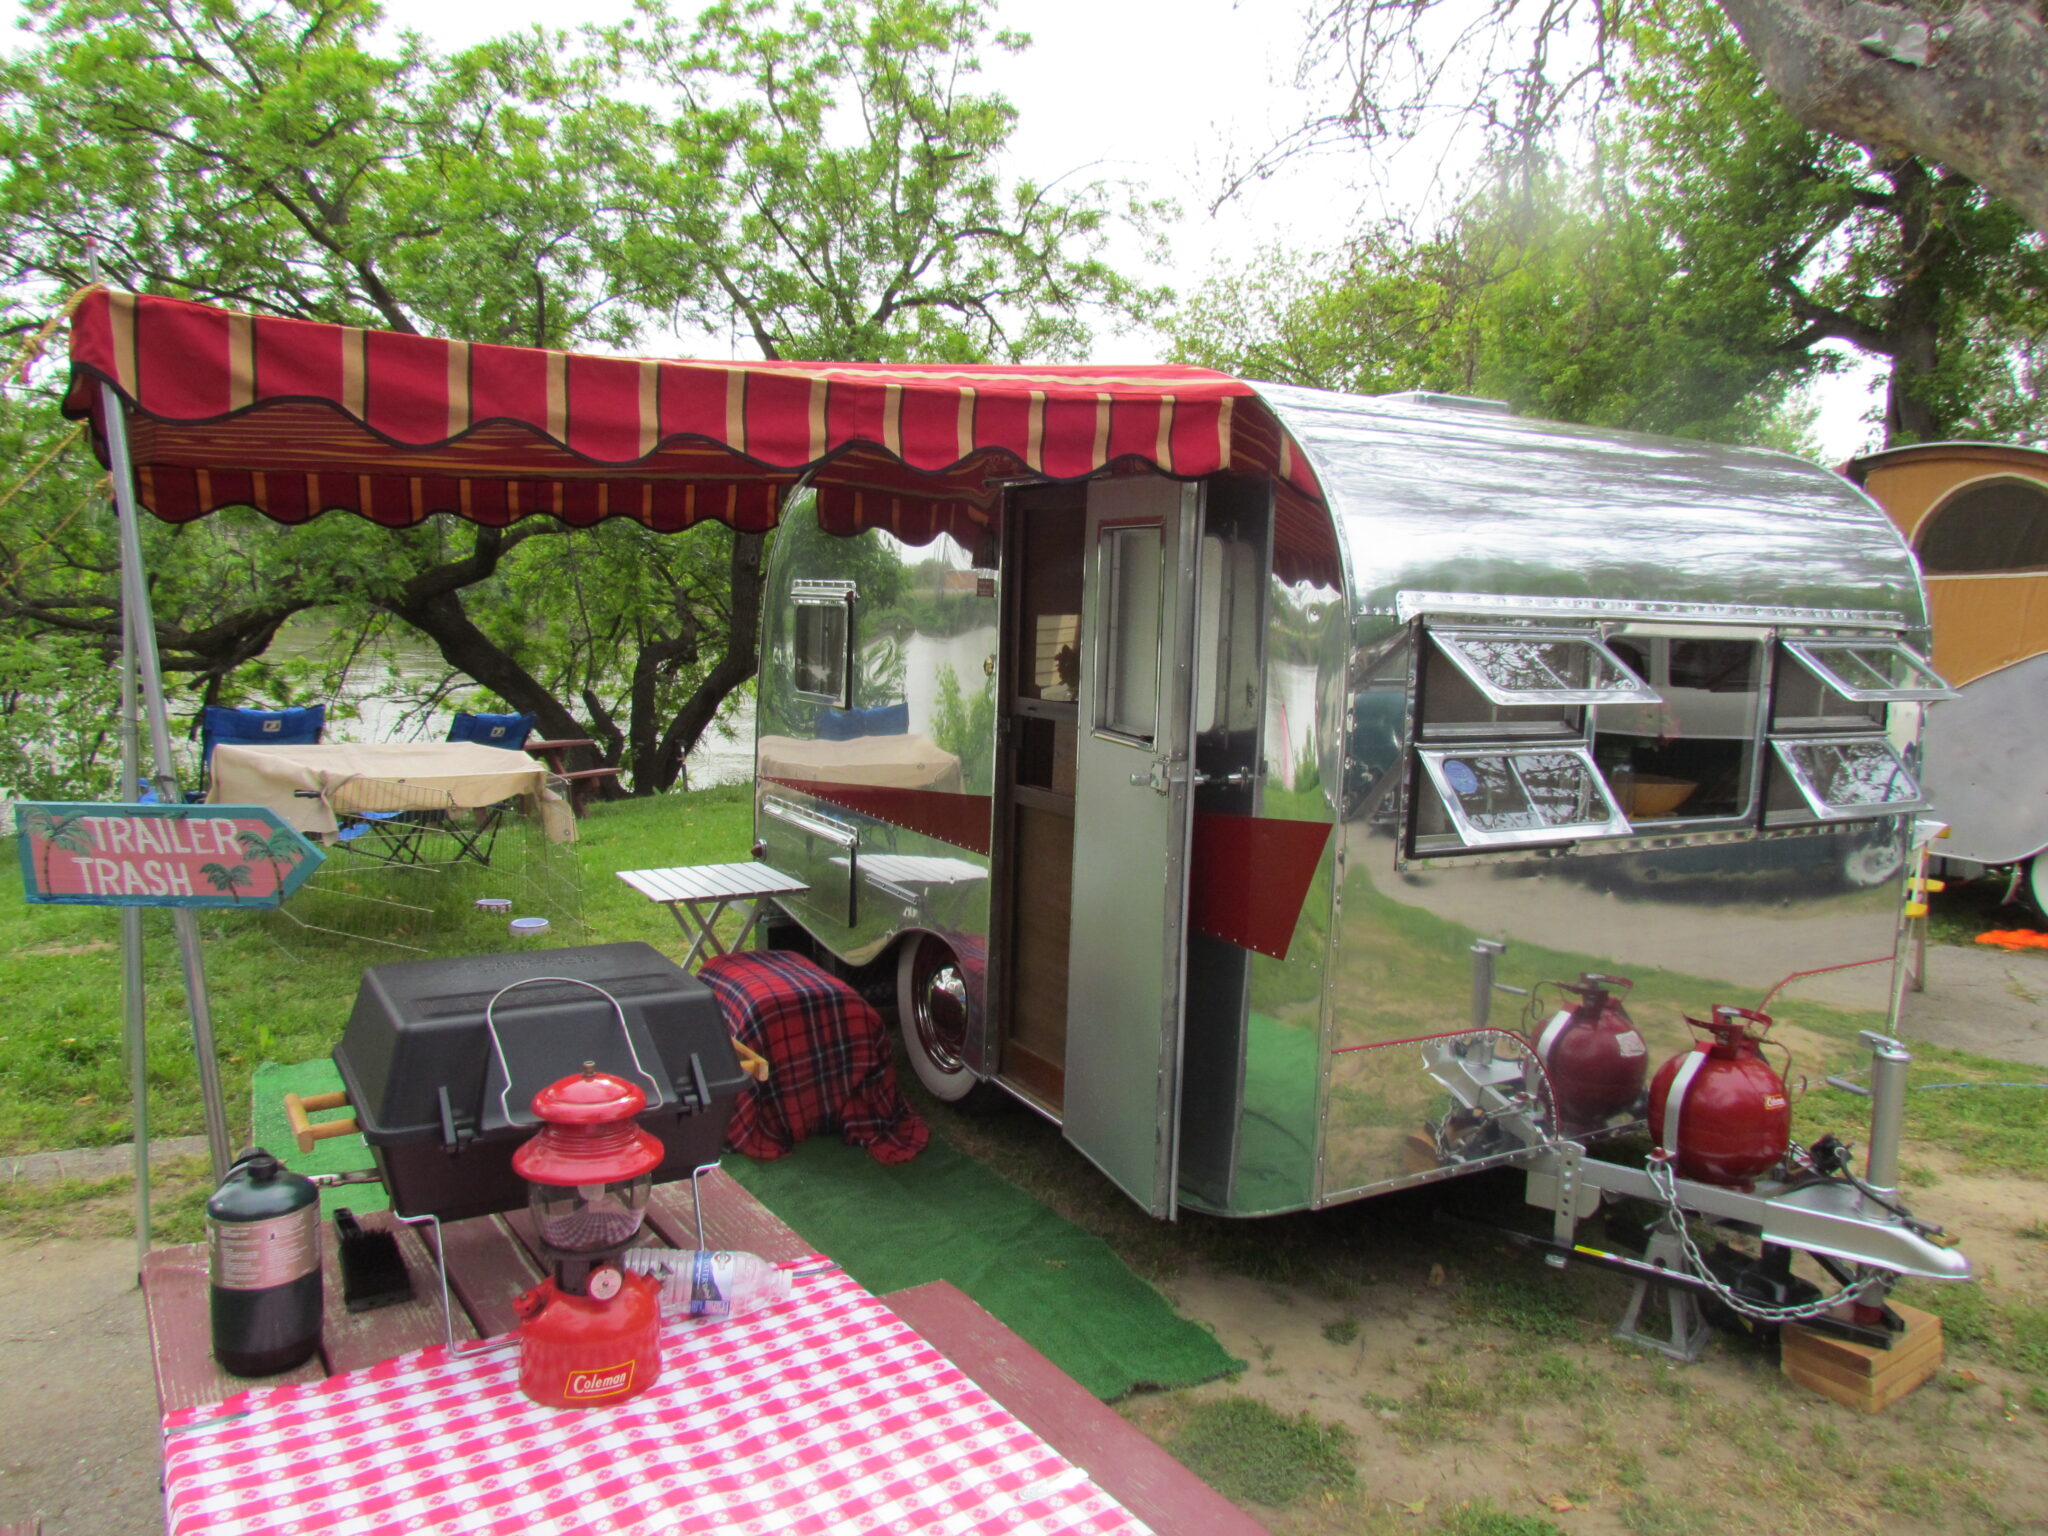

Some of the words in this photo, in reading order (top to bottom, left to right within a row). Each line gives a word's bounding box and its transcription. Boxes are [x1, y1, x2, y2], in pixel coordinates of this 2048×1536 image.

[81, 816, 244, 855] TRAILER
[71, 857, 194, 897] TRASH
[573, 1372, 627, 1394] Coleman
